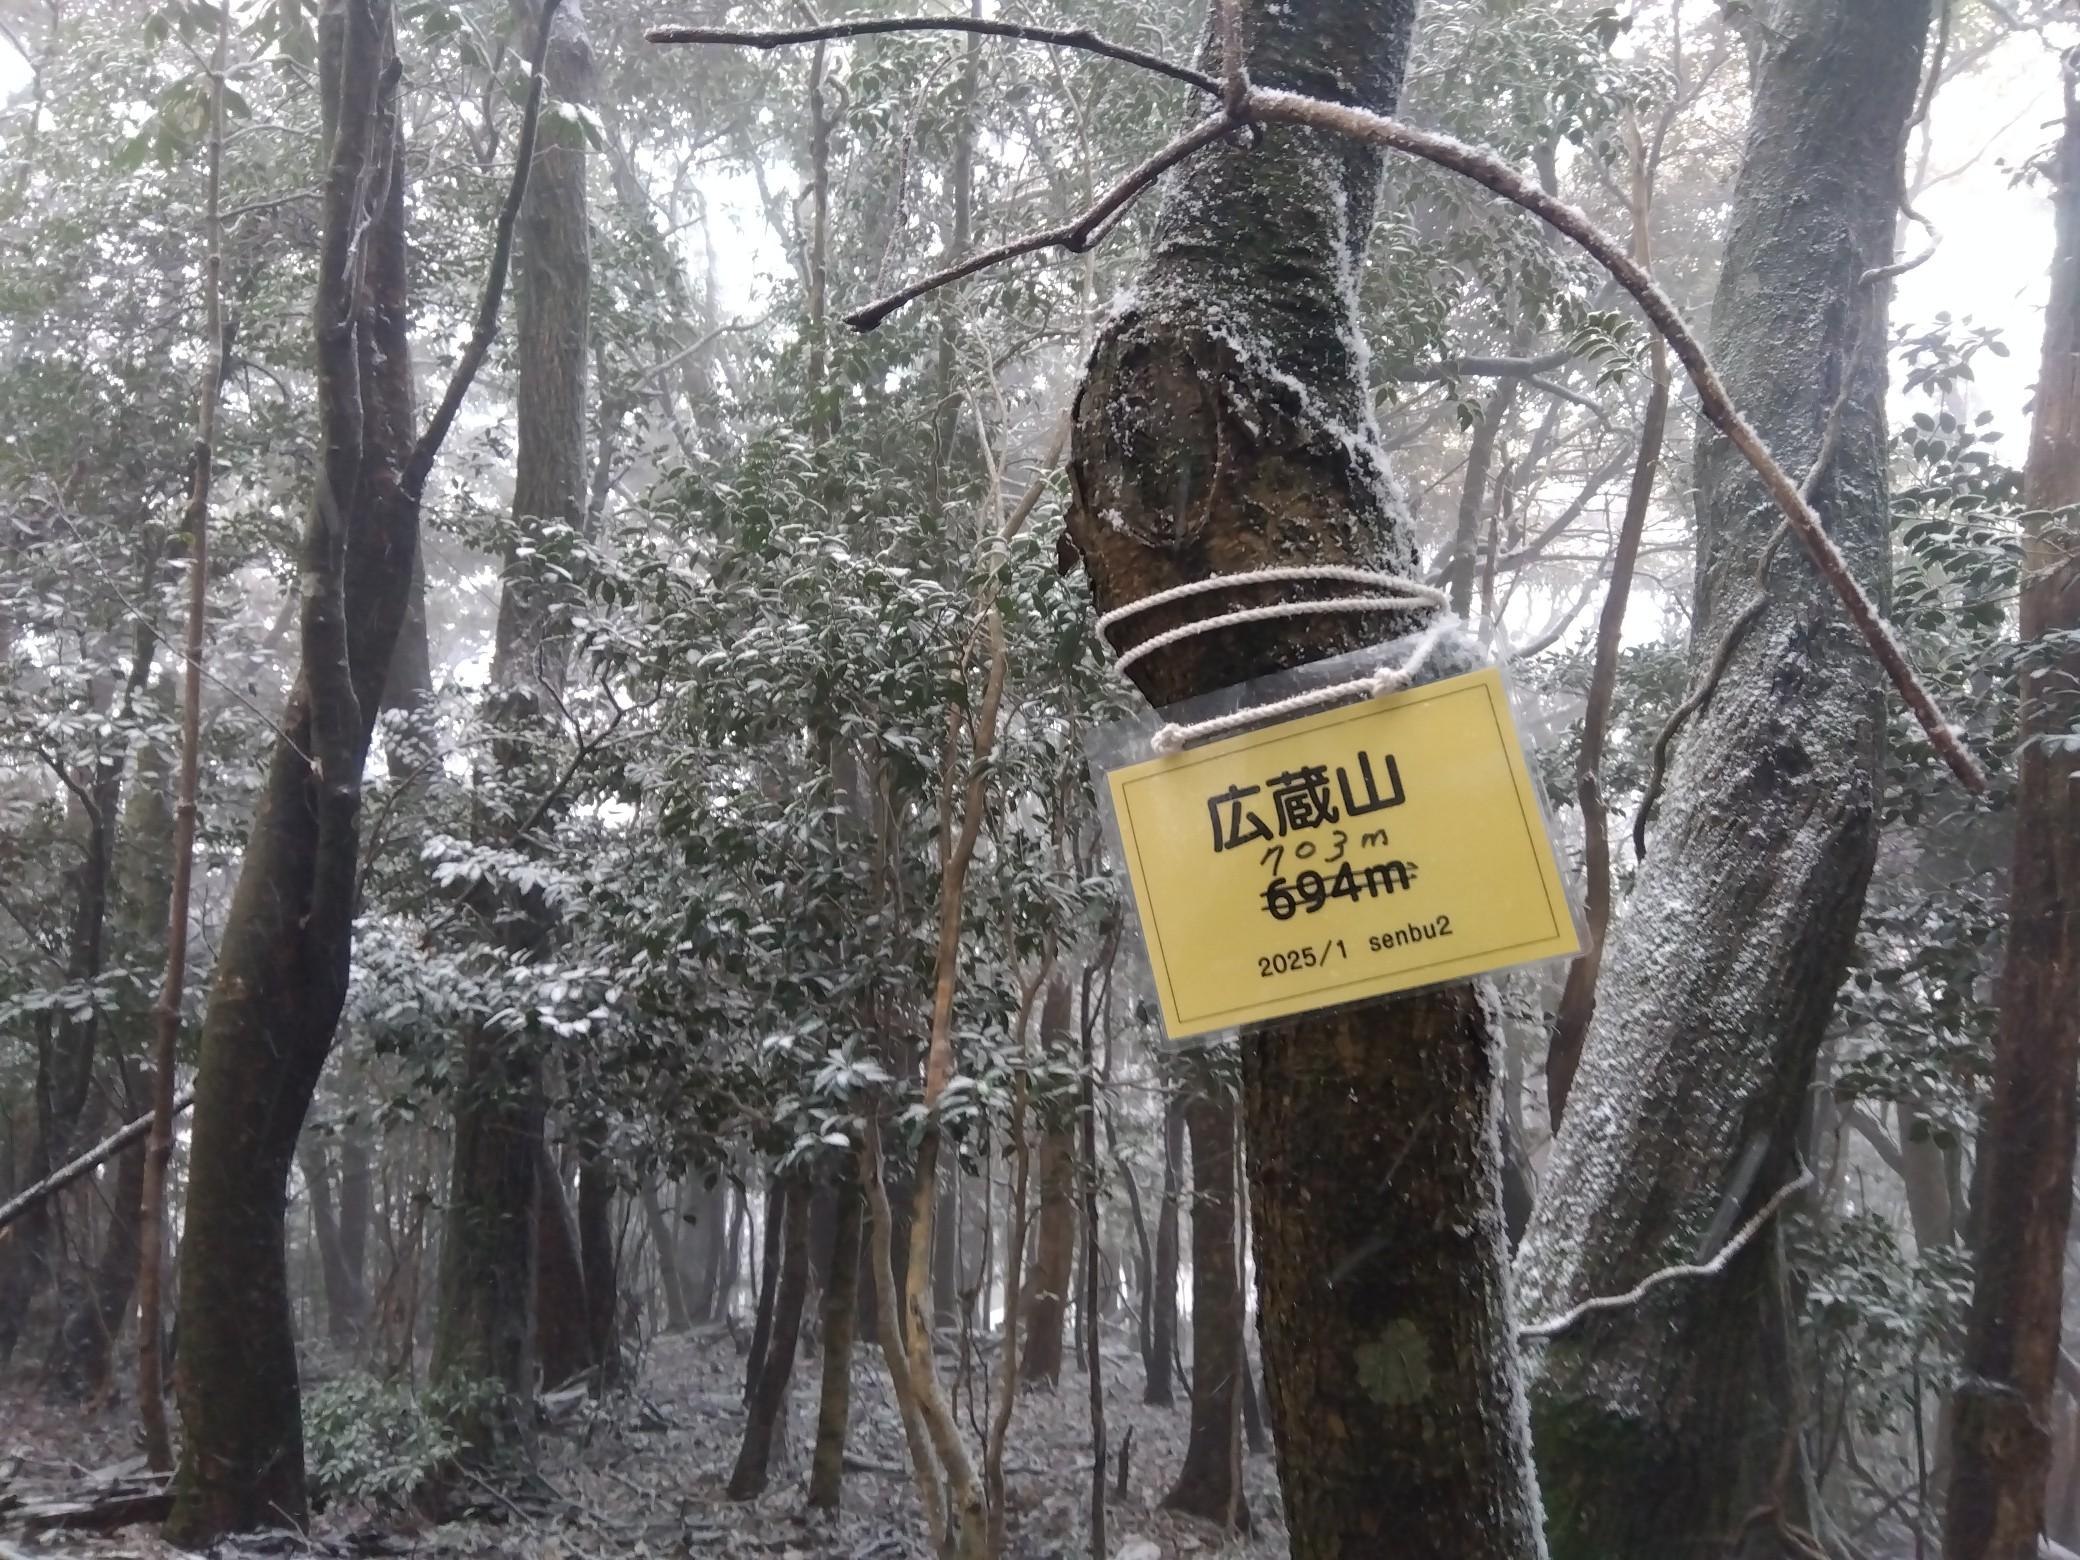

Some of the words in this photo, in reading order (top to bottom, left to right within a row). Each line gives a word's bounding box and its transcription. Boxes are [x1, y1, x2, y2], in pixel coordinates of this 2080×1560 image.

[1207, 751, 1406, 852] 広蔵山
[1266, 861, 1410, 920] 694m
[1258, 939, 1348, 977] 2025/1
[1368, 915, 1453, 951] senbu2
